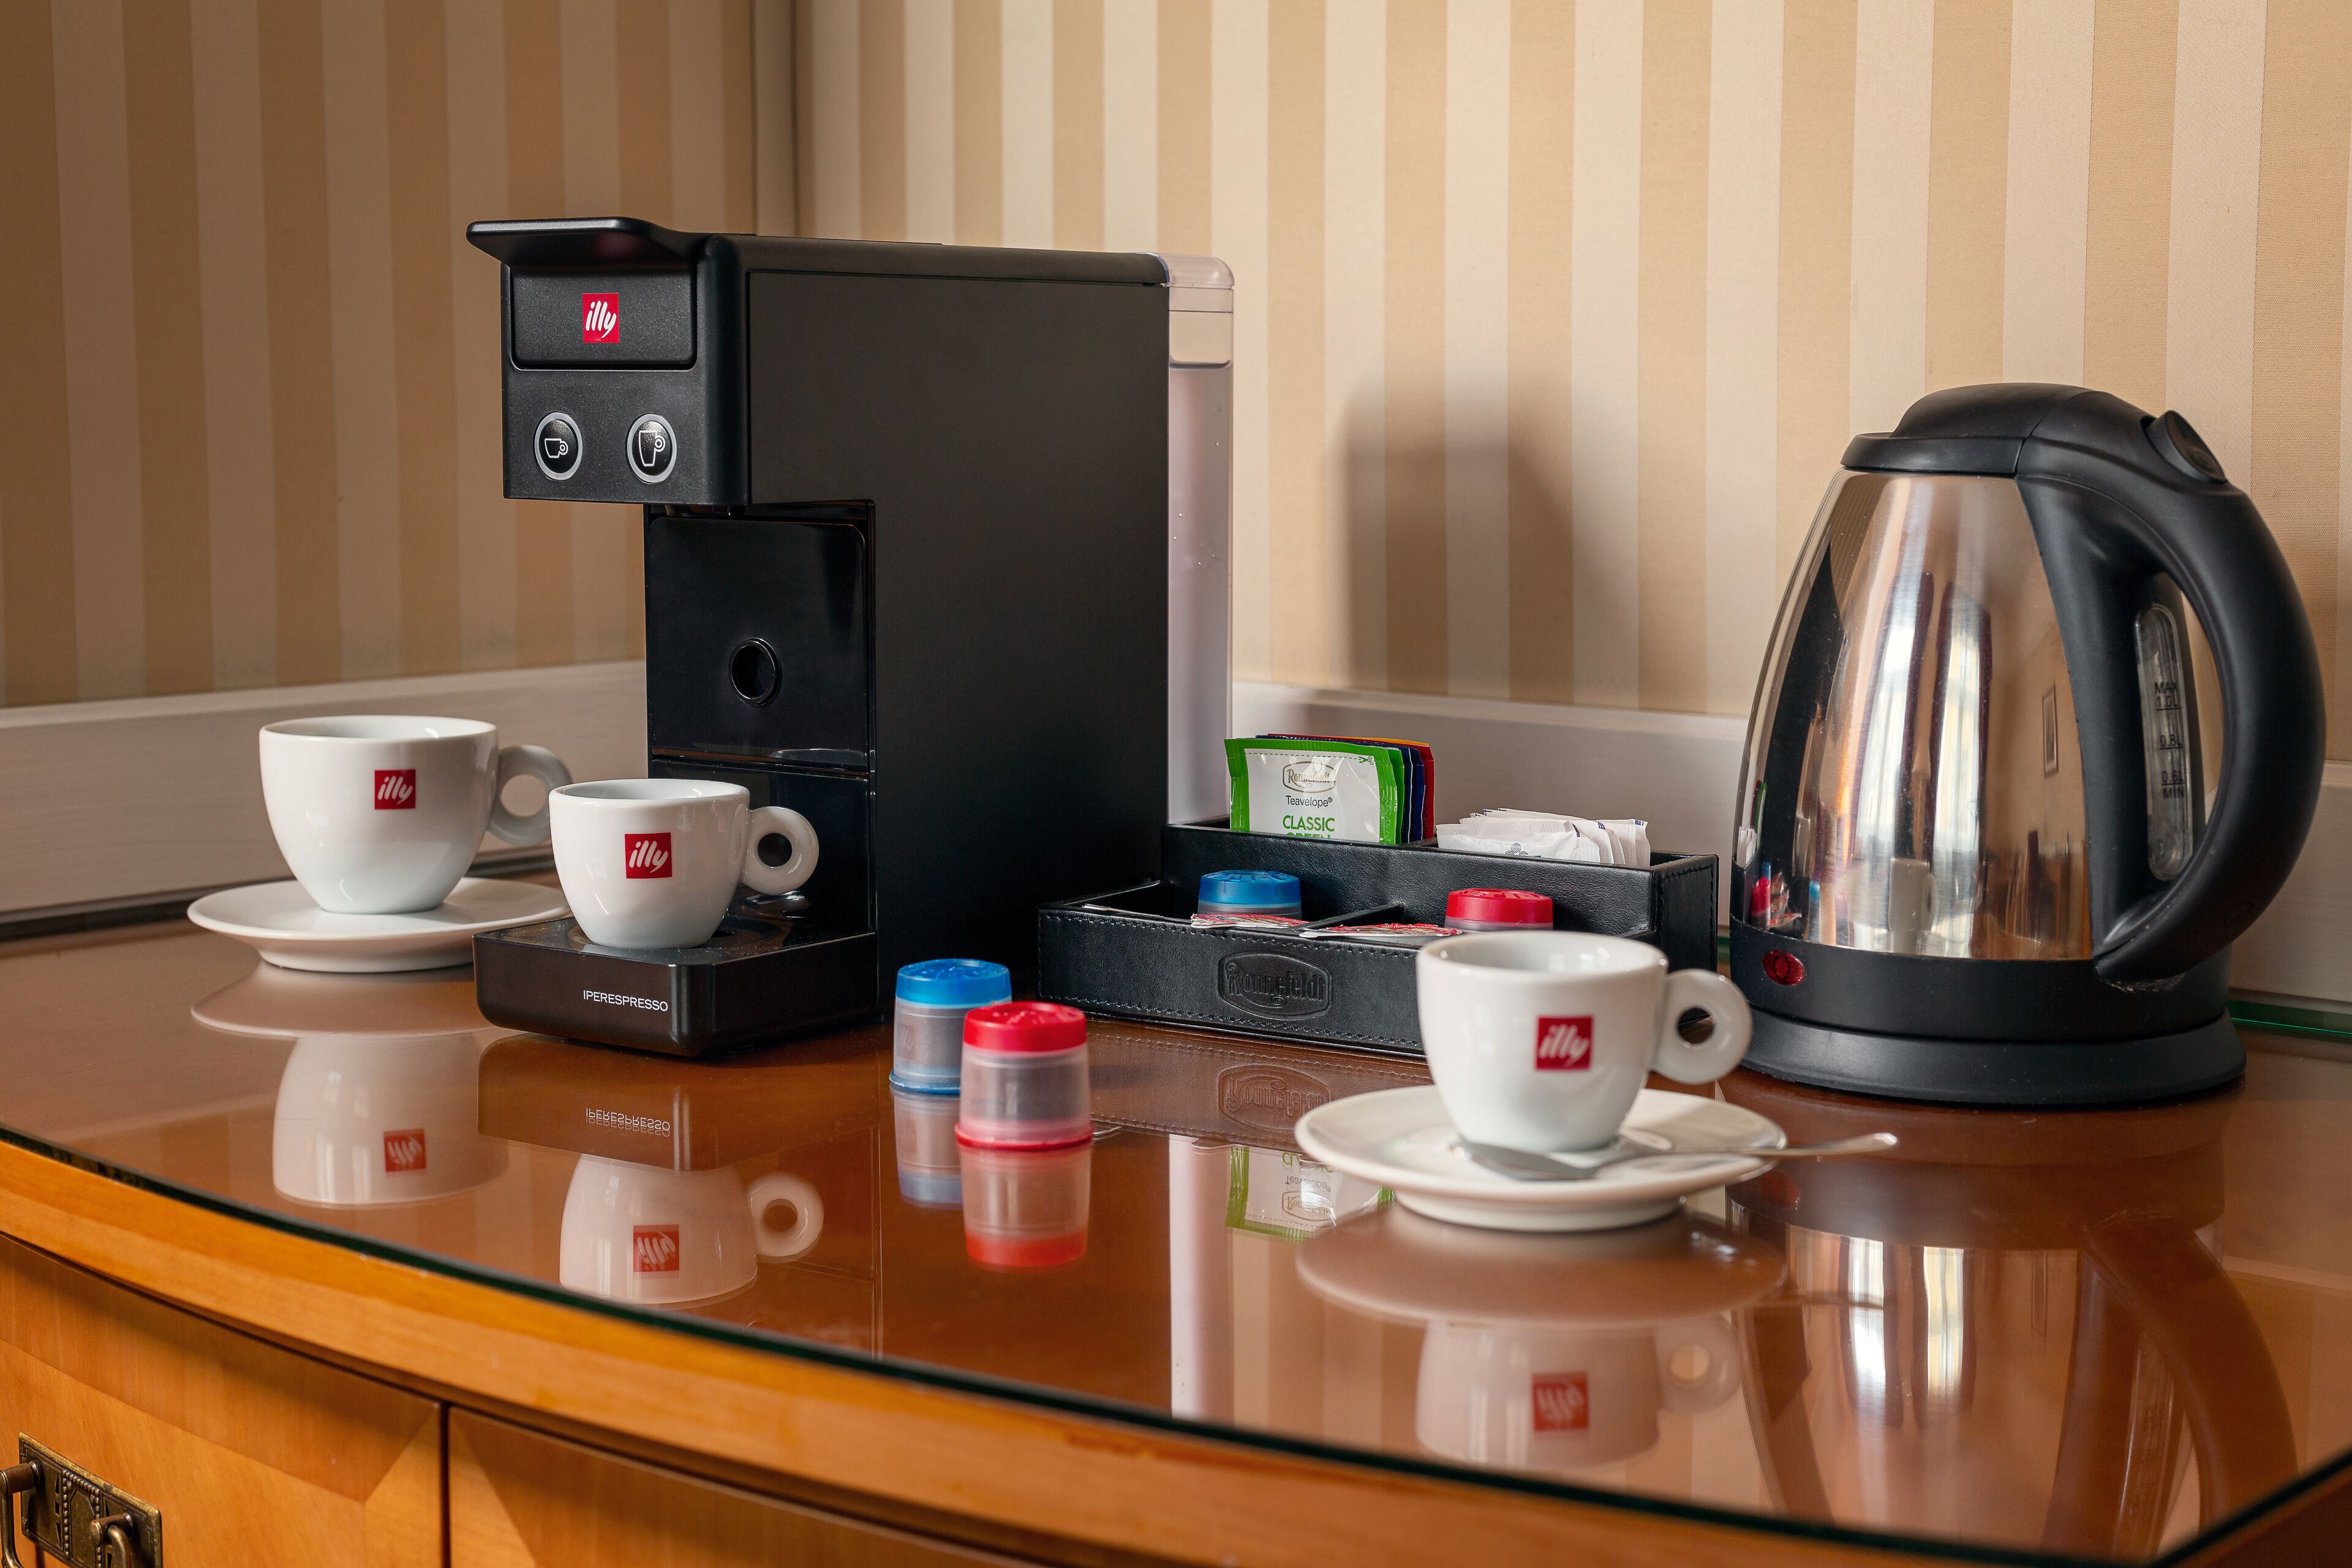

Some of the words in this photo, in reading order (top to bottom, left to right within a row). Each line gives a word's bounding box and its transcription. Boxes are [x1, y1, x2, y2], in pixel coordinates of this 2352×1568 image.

[586, 300, 617, 338] illy
[2155, 682, 2178, 693] MAX
[377, 775, 413, 801] illy
[2163, 786, 2185, 799] MIN
[1283, 815, 1335, 832] CLASSIC
[628, 840, 669, 873] illy
[583, 990, 668, 1011] IPERESPRESSO
[1539, 1024, 1589, 1066] illy
